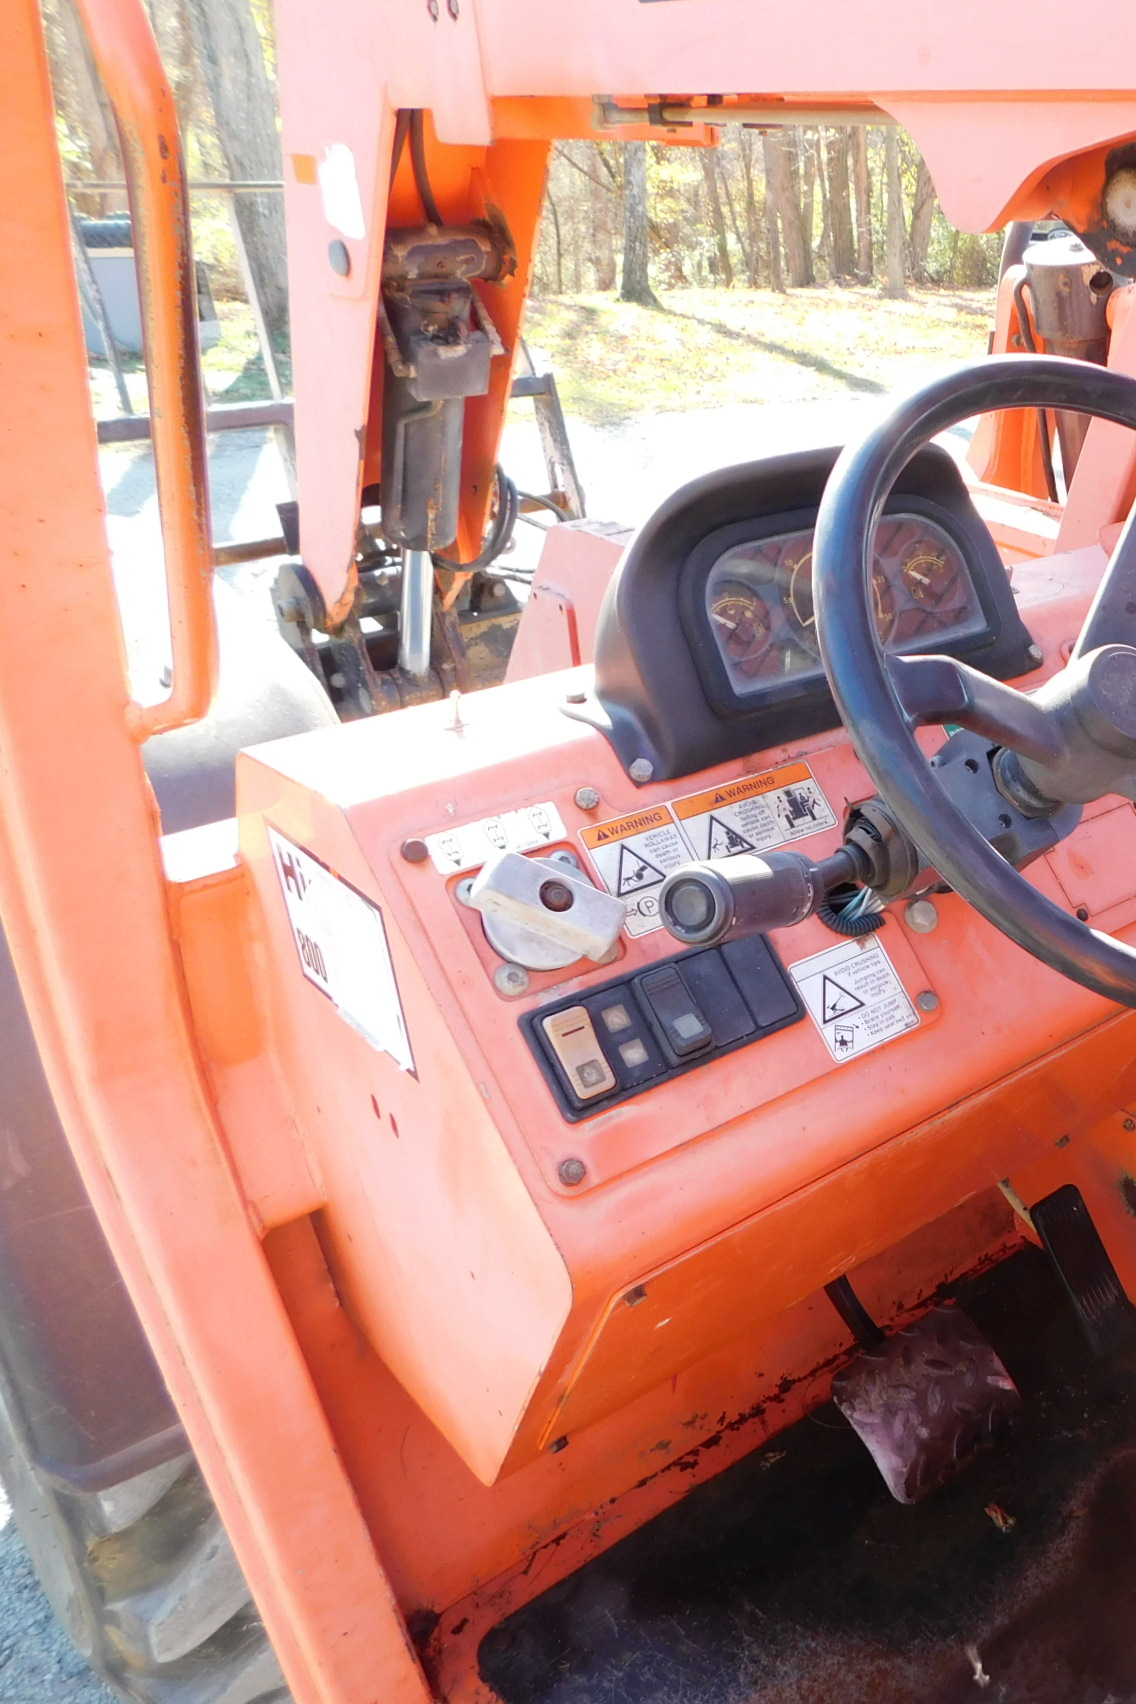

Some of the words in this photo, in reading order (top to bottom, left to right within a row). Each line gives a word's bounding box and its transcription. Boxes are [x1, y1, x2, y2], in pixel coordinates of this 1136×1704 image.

[725, 776, 776, 798] WARNING
[607, 812, 663, 836] WARNING
[644, 829, 670, 842] VEHICLE
